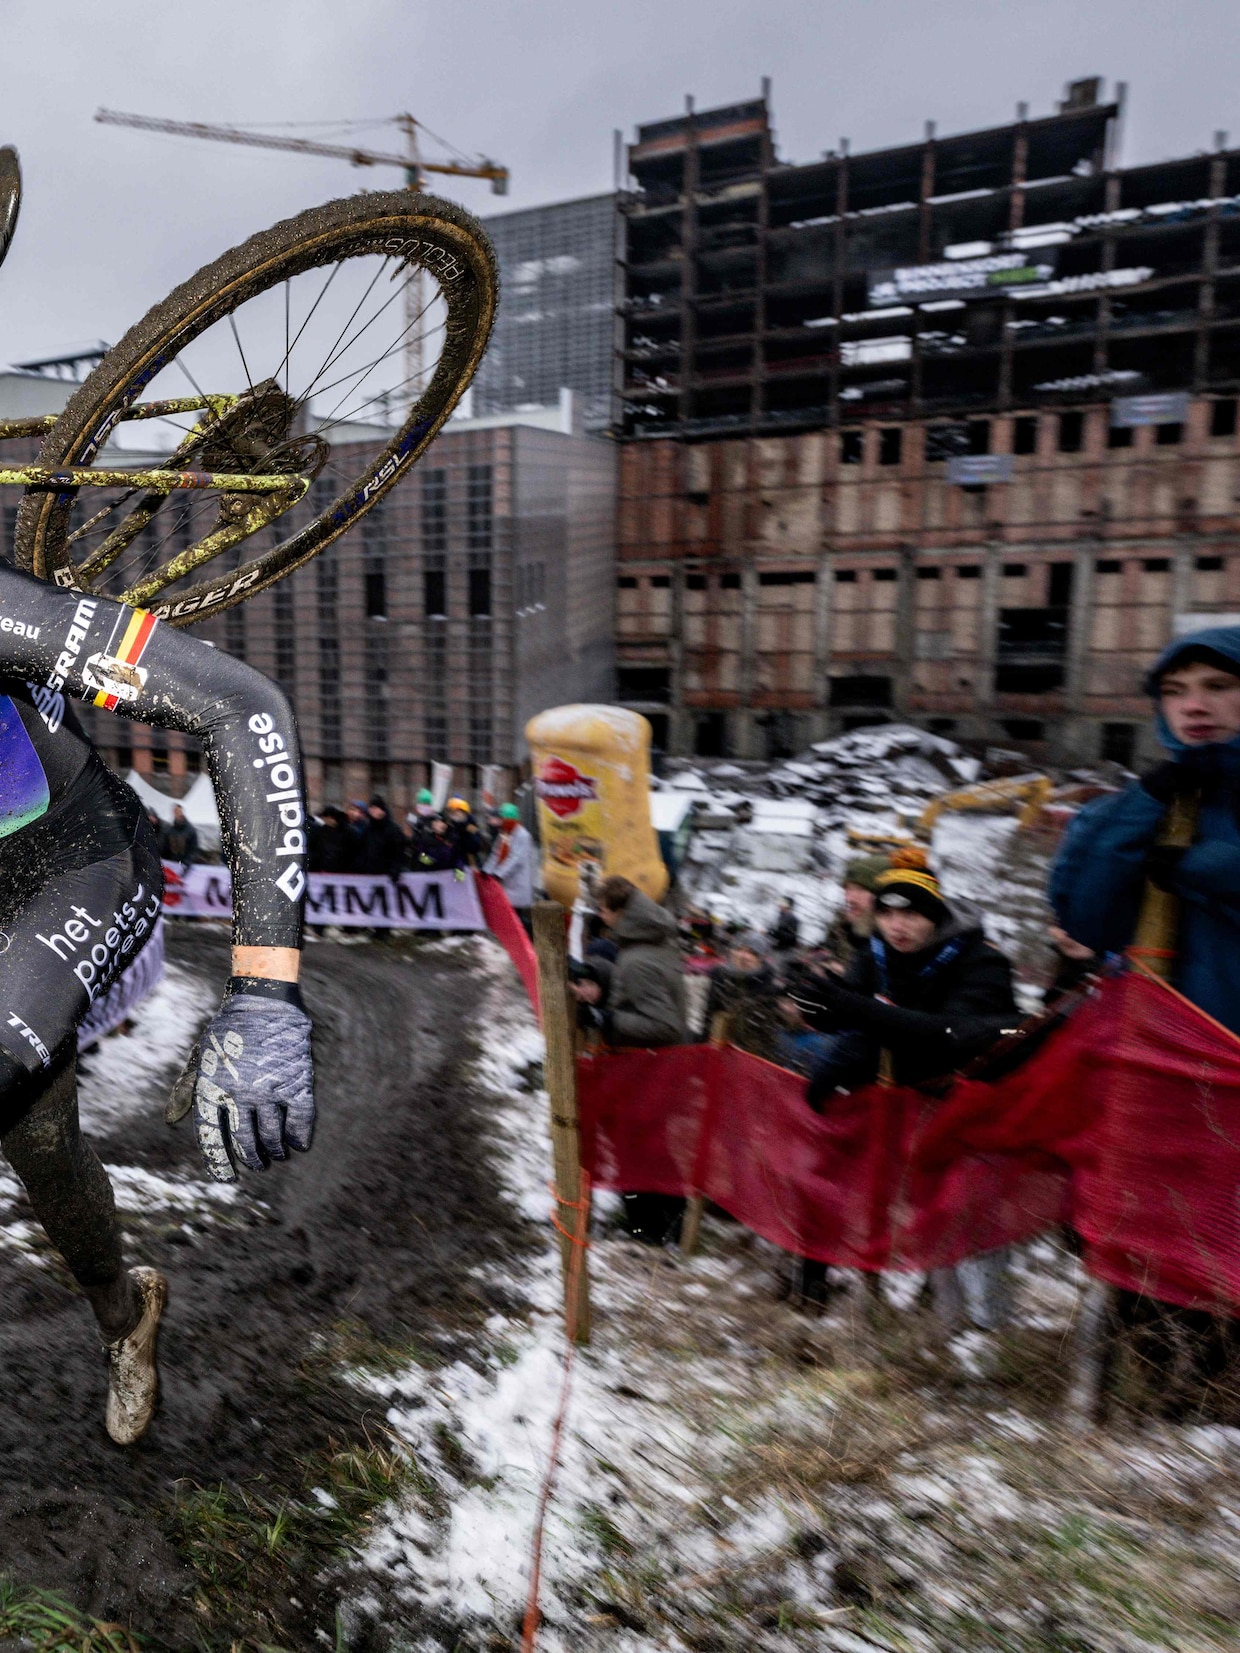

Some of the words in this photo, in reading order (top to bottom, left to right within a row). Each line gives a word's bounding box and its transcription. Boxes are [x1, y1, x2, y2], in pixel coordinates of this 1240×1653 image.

[46, 599, 99, 692] SRAM
[248, 712, 307, 856] baloise
[35, 904, 103, 961] het
